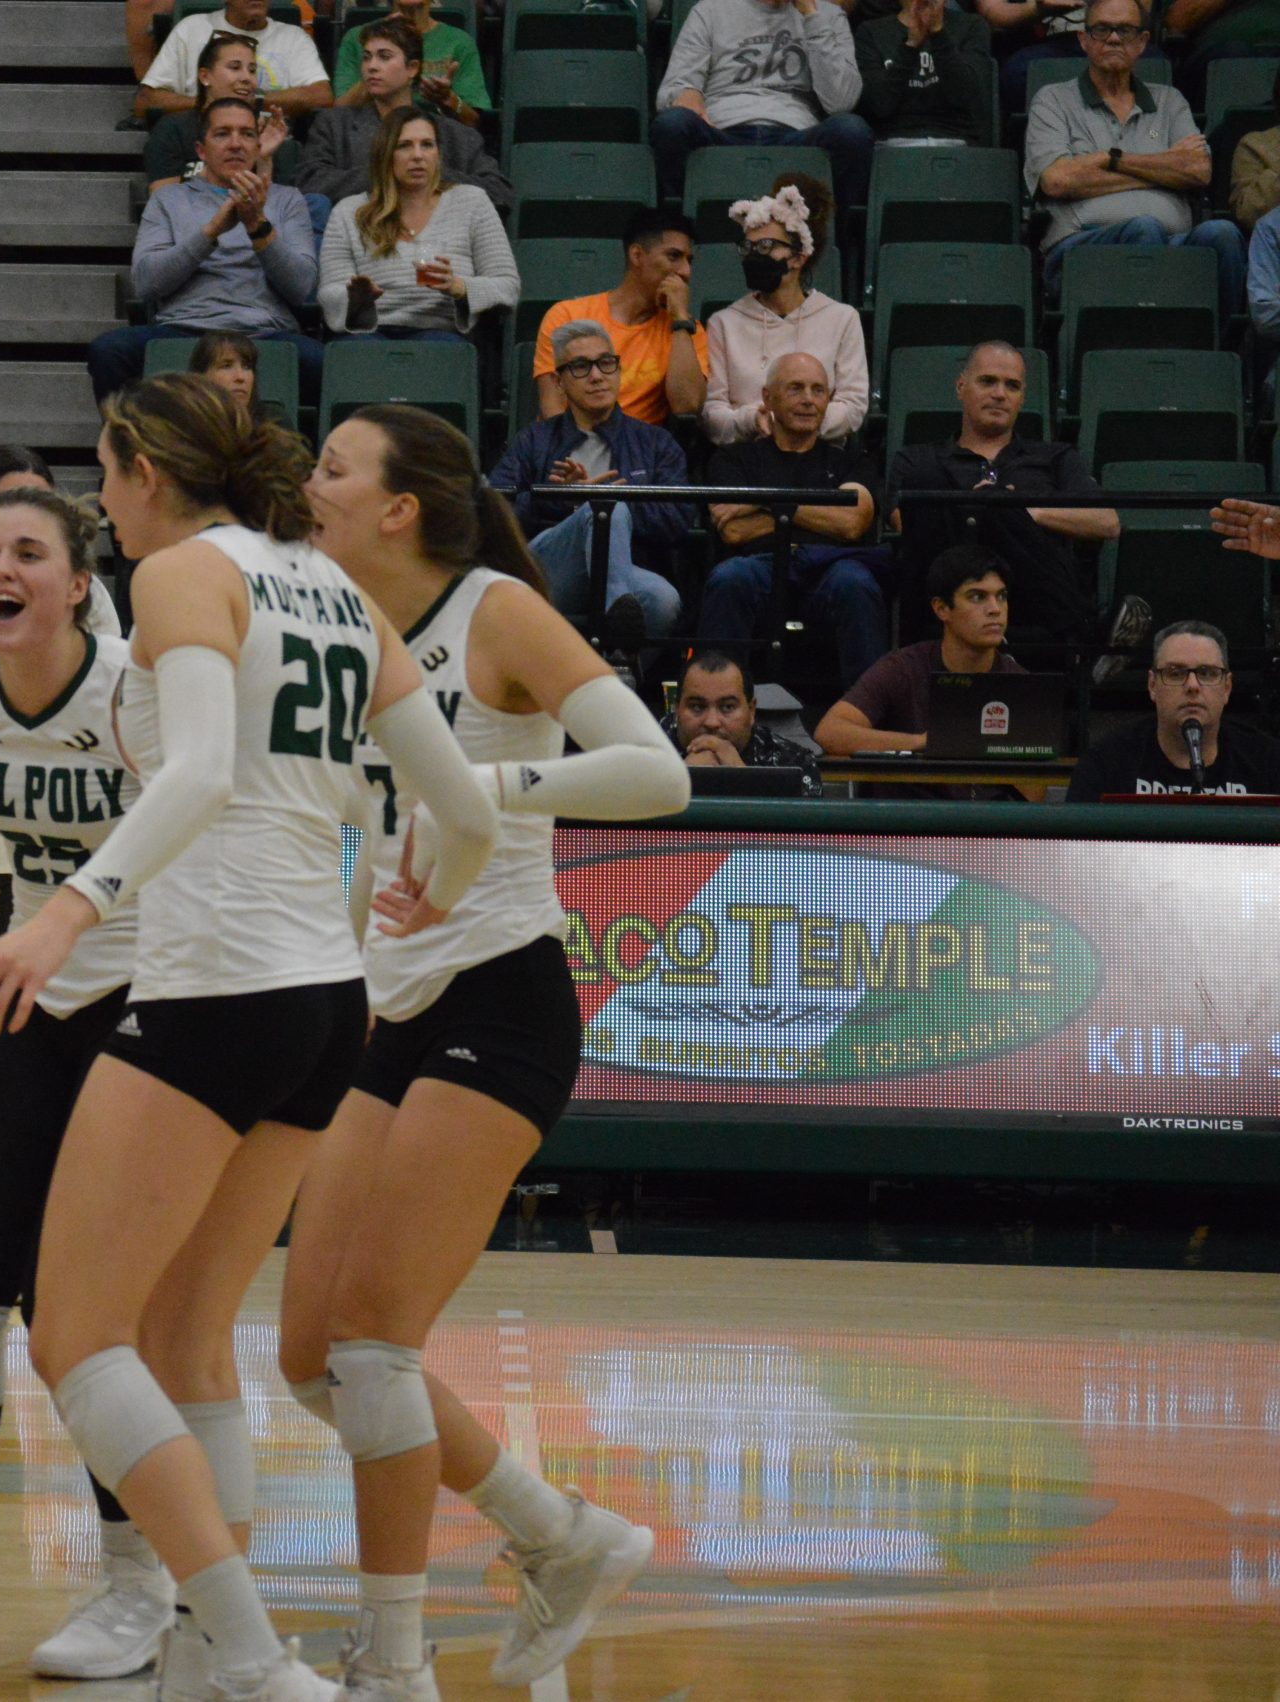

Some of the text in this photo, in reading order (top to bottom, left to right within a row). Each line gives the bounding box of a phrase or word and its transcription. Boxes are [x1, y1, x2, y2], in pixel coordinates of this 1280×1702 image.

[269, 631, 369, 765] 20
[986, 745, 1054, 754] JOURNALISM MATTERS
[24, 765, 126, 824] POLY
[565, 904, 1053, 992] ACO TEMPLE
[1087, 1024, 1252, 1077] Killer
[1123, 1117, 1245, 1132] DAKTRONICS
